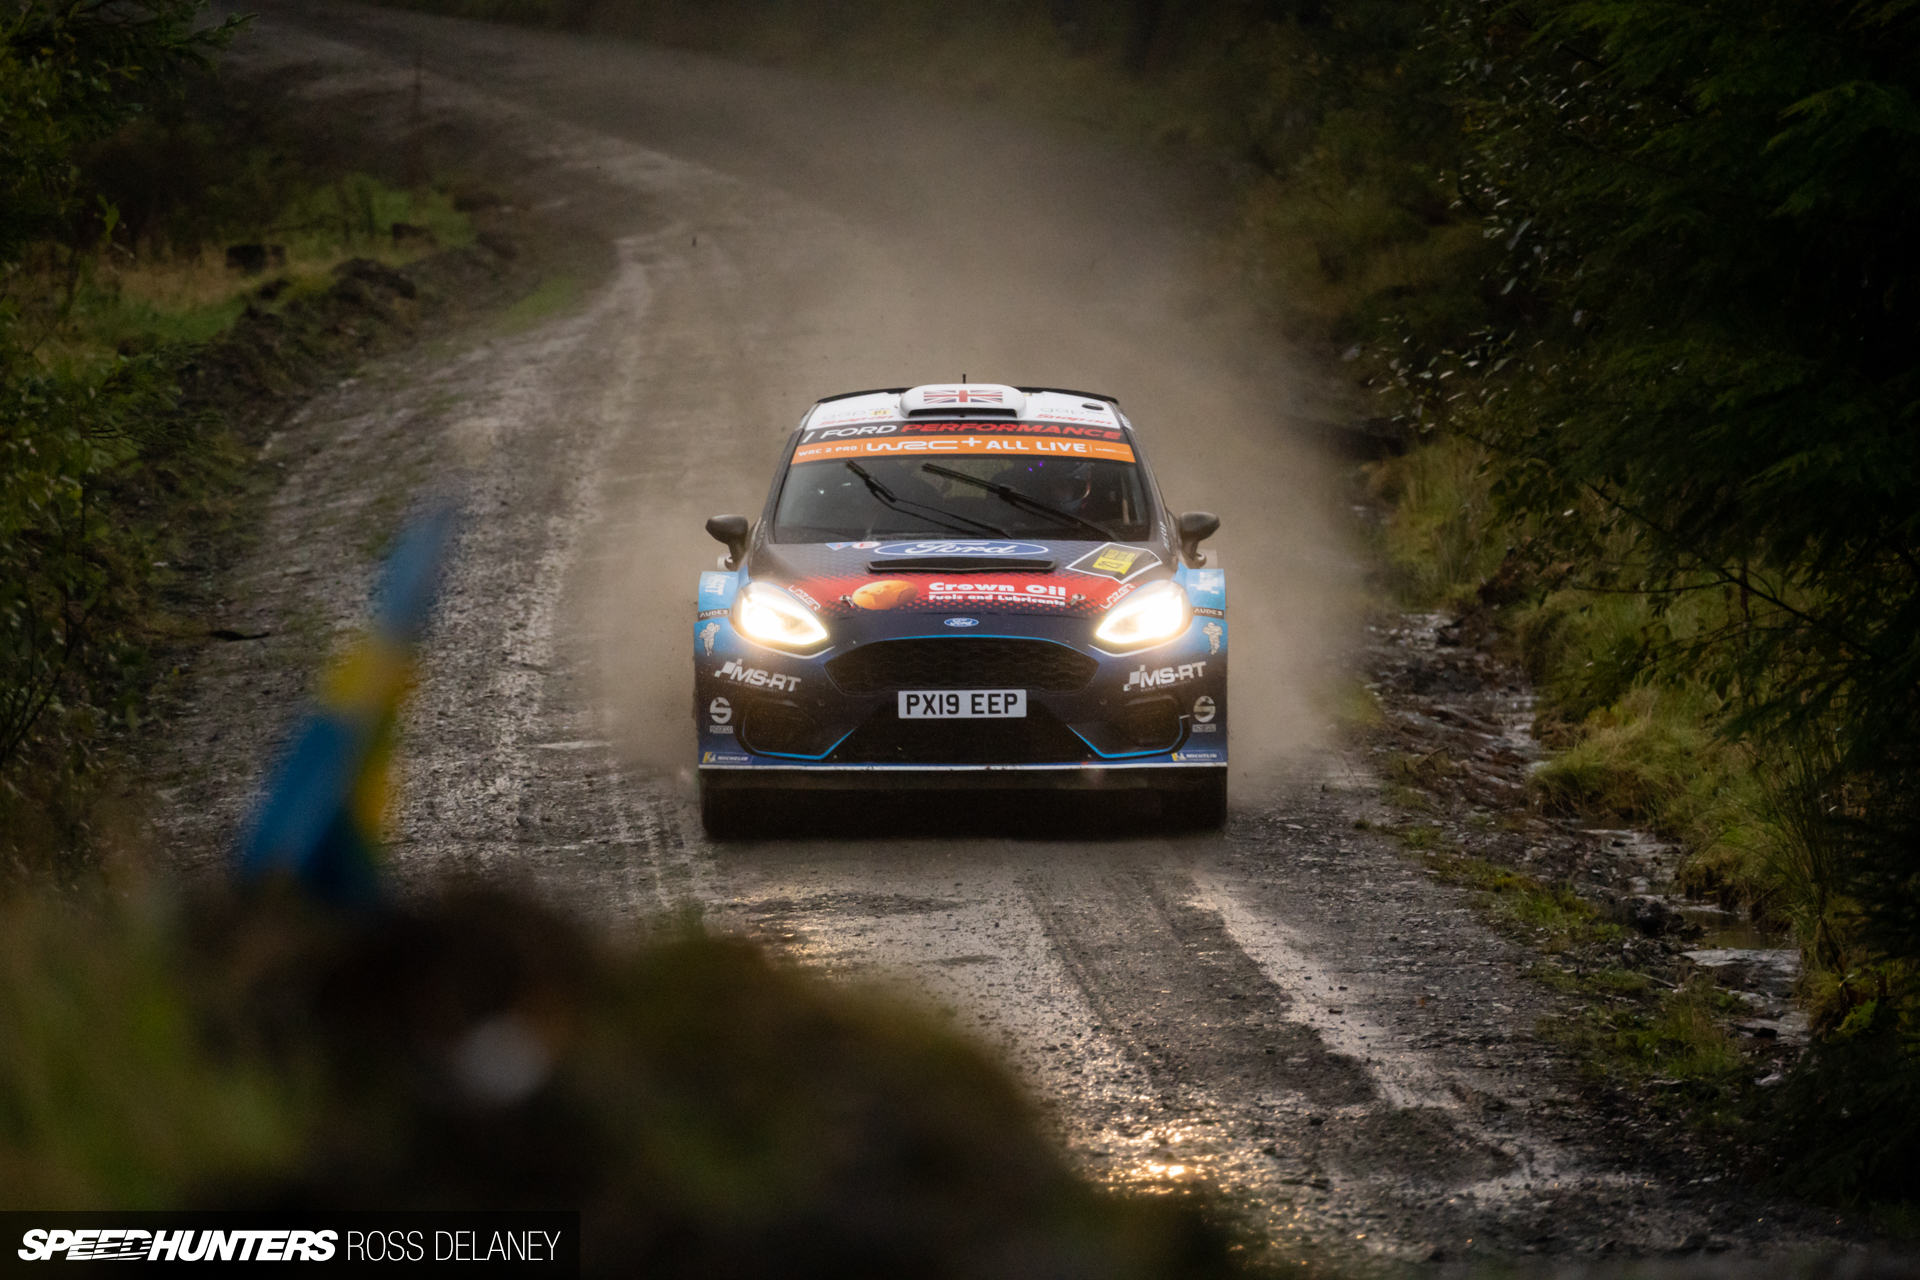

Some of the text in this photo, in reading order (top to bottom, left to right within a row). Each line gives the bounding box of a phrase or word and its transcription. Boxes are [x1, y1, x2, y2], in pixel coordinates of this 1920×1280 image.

[820, 423, 1122, 440] FORD PERFORMANCE
[798, 448, 822, 456] WRC
[986, 440, 1029, 450] ALL
[1036, 441, 1087, 453] LIVE
[905, 542, 1017, 554] Ford
[929, 582, 1066, 597] Crown Oil
[998, 595, 1066, 606] Lubricants
[700, 608, 728, 617] AUDES
[1194, 607, 1223, 616] AUDES
[906, 693, 1018, 715] PX19 EEP
